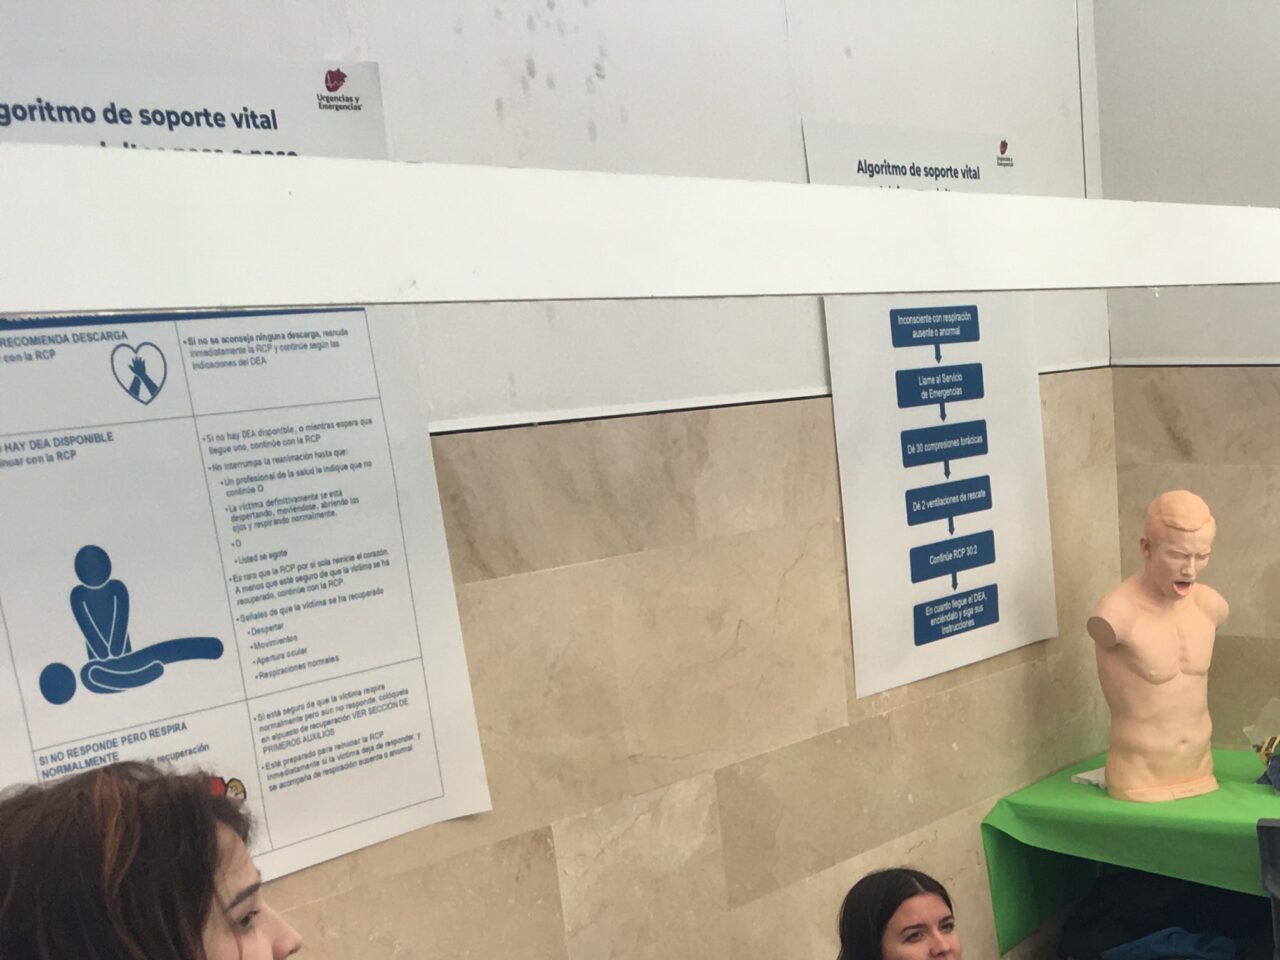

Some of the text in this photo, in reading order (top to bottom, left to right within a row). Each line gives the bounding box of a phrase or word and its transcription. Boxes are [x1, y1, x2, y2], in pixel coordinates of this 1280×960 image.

[317, 94, 353, 103] Urgencias
[318, 102, 361, 111] Emergencias
[102, 102, 133, 124] de
[139, 108, 226, 131] soporte
[231, 107, 278, 130] vital
[857, 159, 981, 180] Algoritmo de soporte vital
[0, 330, 128, 348] RECOMIENDA DESCARGA
[256, 343, 272, 352] RCP
[3, 349, 56, 363] con la RCP
[250, 356, 266, 365] DEA
[919, 372, 962, 385] Llame al Servicio
[921, 386, 962, 399] de Emergencias
[242, 429, 256, 438] DEA
[305, 434, 320, 443] RCP
[3, 432, 114, 453] HAY DEA DISPONIBLE
[917, 443, 923, 452] 30
[25, 454, 43, 465] con
[46, 453, 54, 463] la
[56, 449, 77, 461] RCP
[922, 500, 925, 509] 2
[960, 493, 966, 501] de
[954, 548, 965, 559] RCP
[966, 545, 977, 556] 30:2
[280, 564, 296, 574] RCP
[328, 578, 343, 588] RCP
[926, 607, 933, 615] En
[39, 722, 187, 766] SI NO RESPONDE PERO RESPIRA
[41, 751, 119, 778] NORMALMENTE
